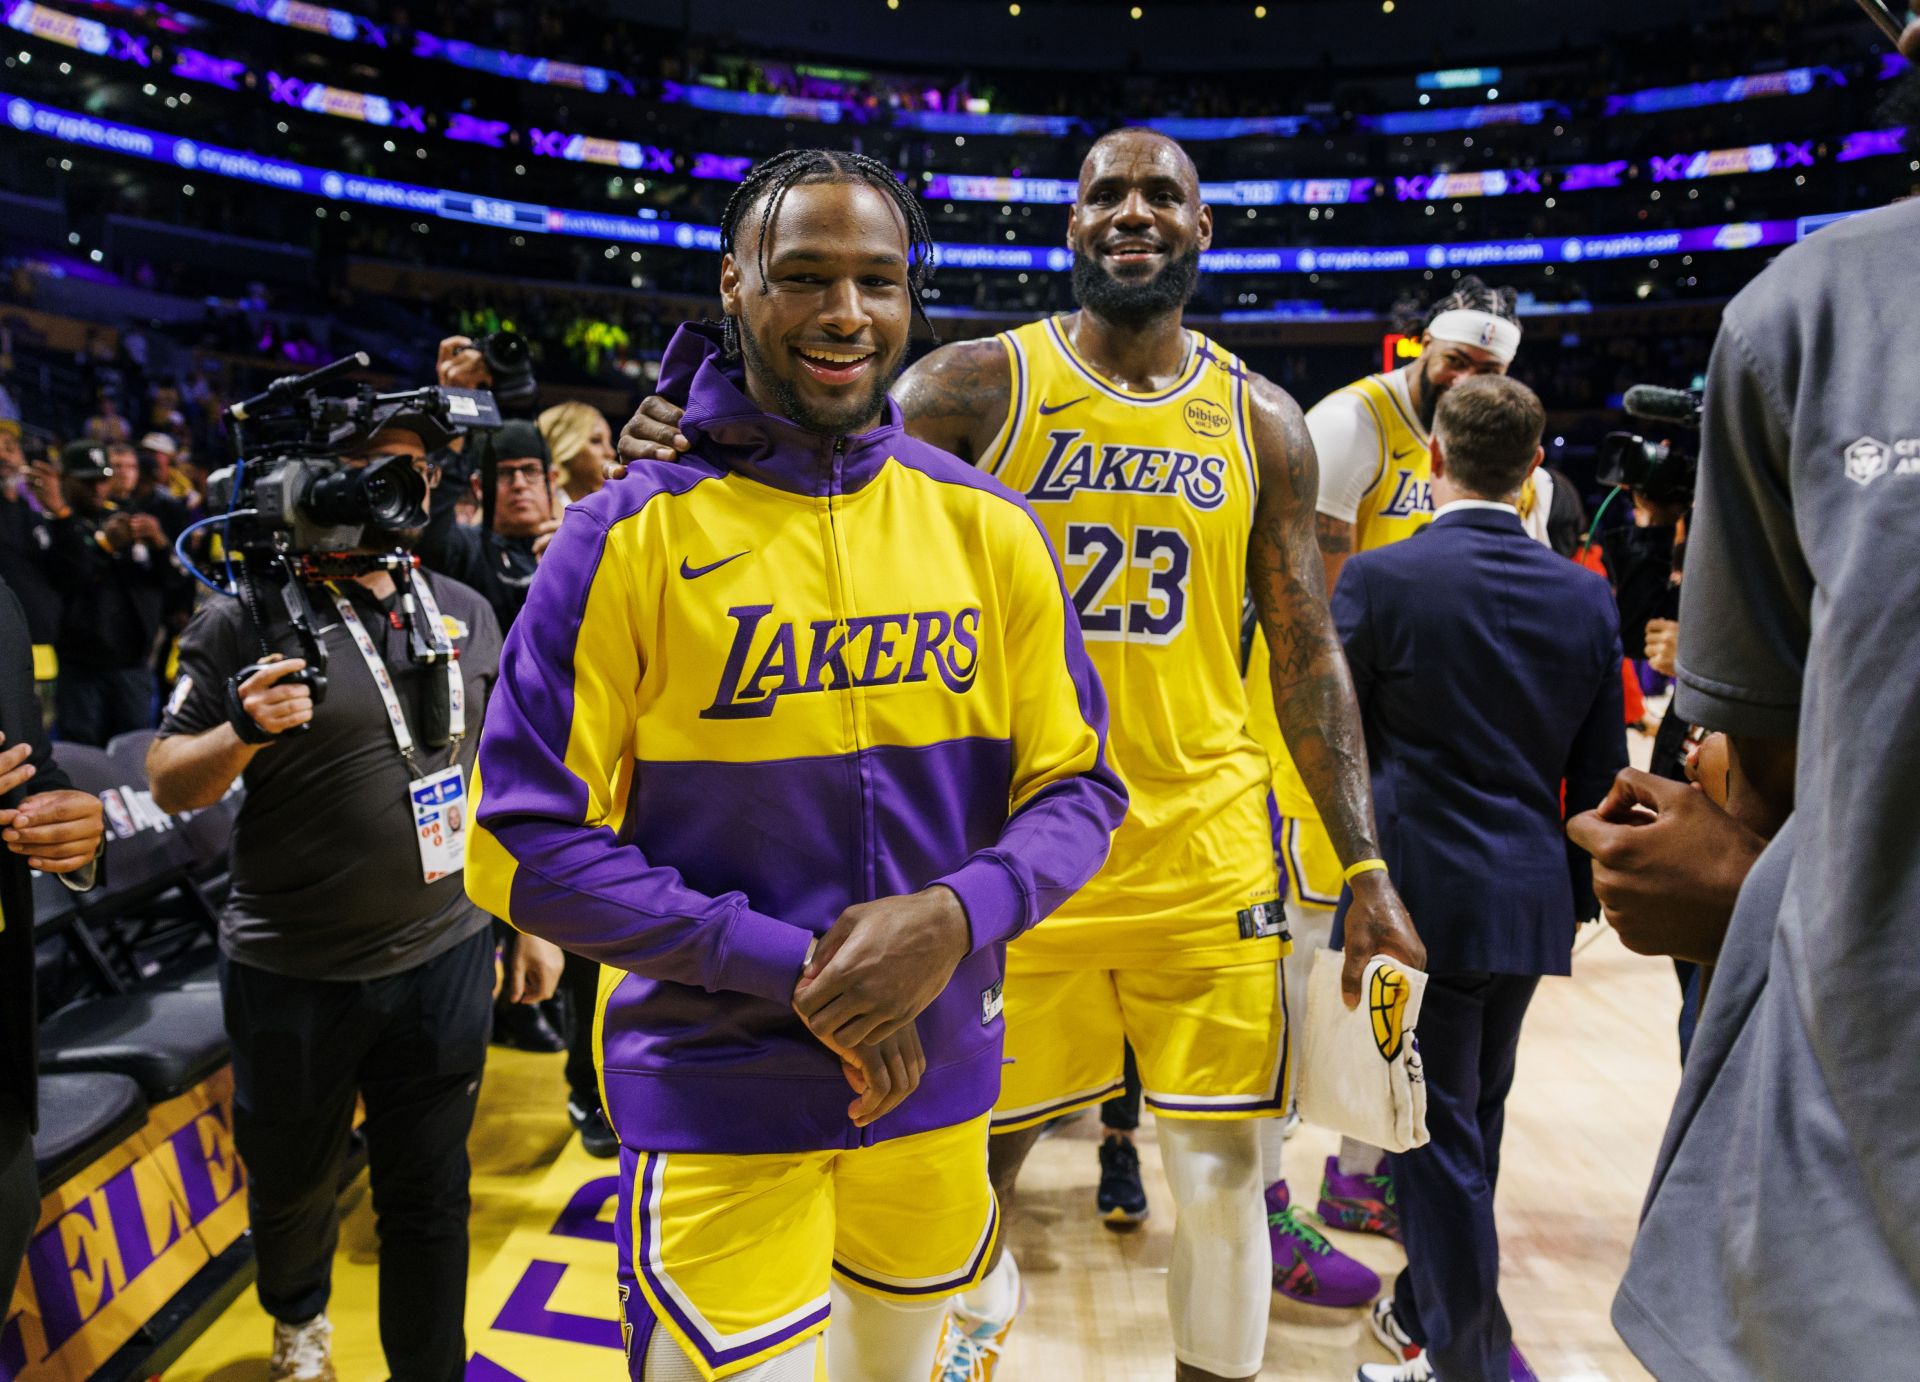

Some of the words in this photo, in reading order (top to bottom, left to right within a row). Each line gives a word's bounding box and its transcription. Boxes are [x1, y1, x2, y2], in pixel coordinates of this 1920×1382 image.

[1188, 406, 1228, 428] bibigo
[1025, 430, 1228, 512] LAKERS
[1065, 522, 1192, 645] 23
[699, 604, 981, 720] LAKERS
